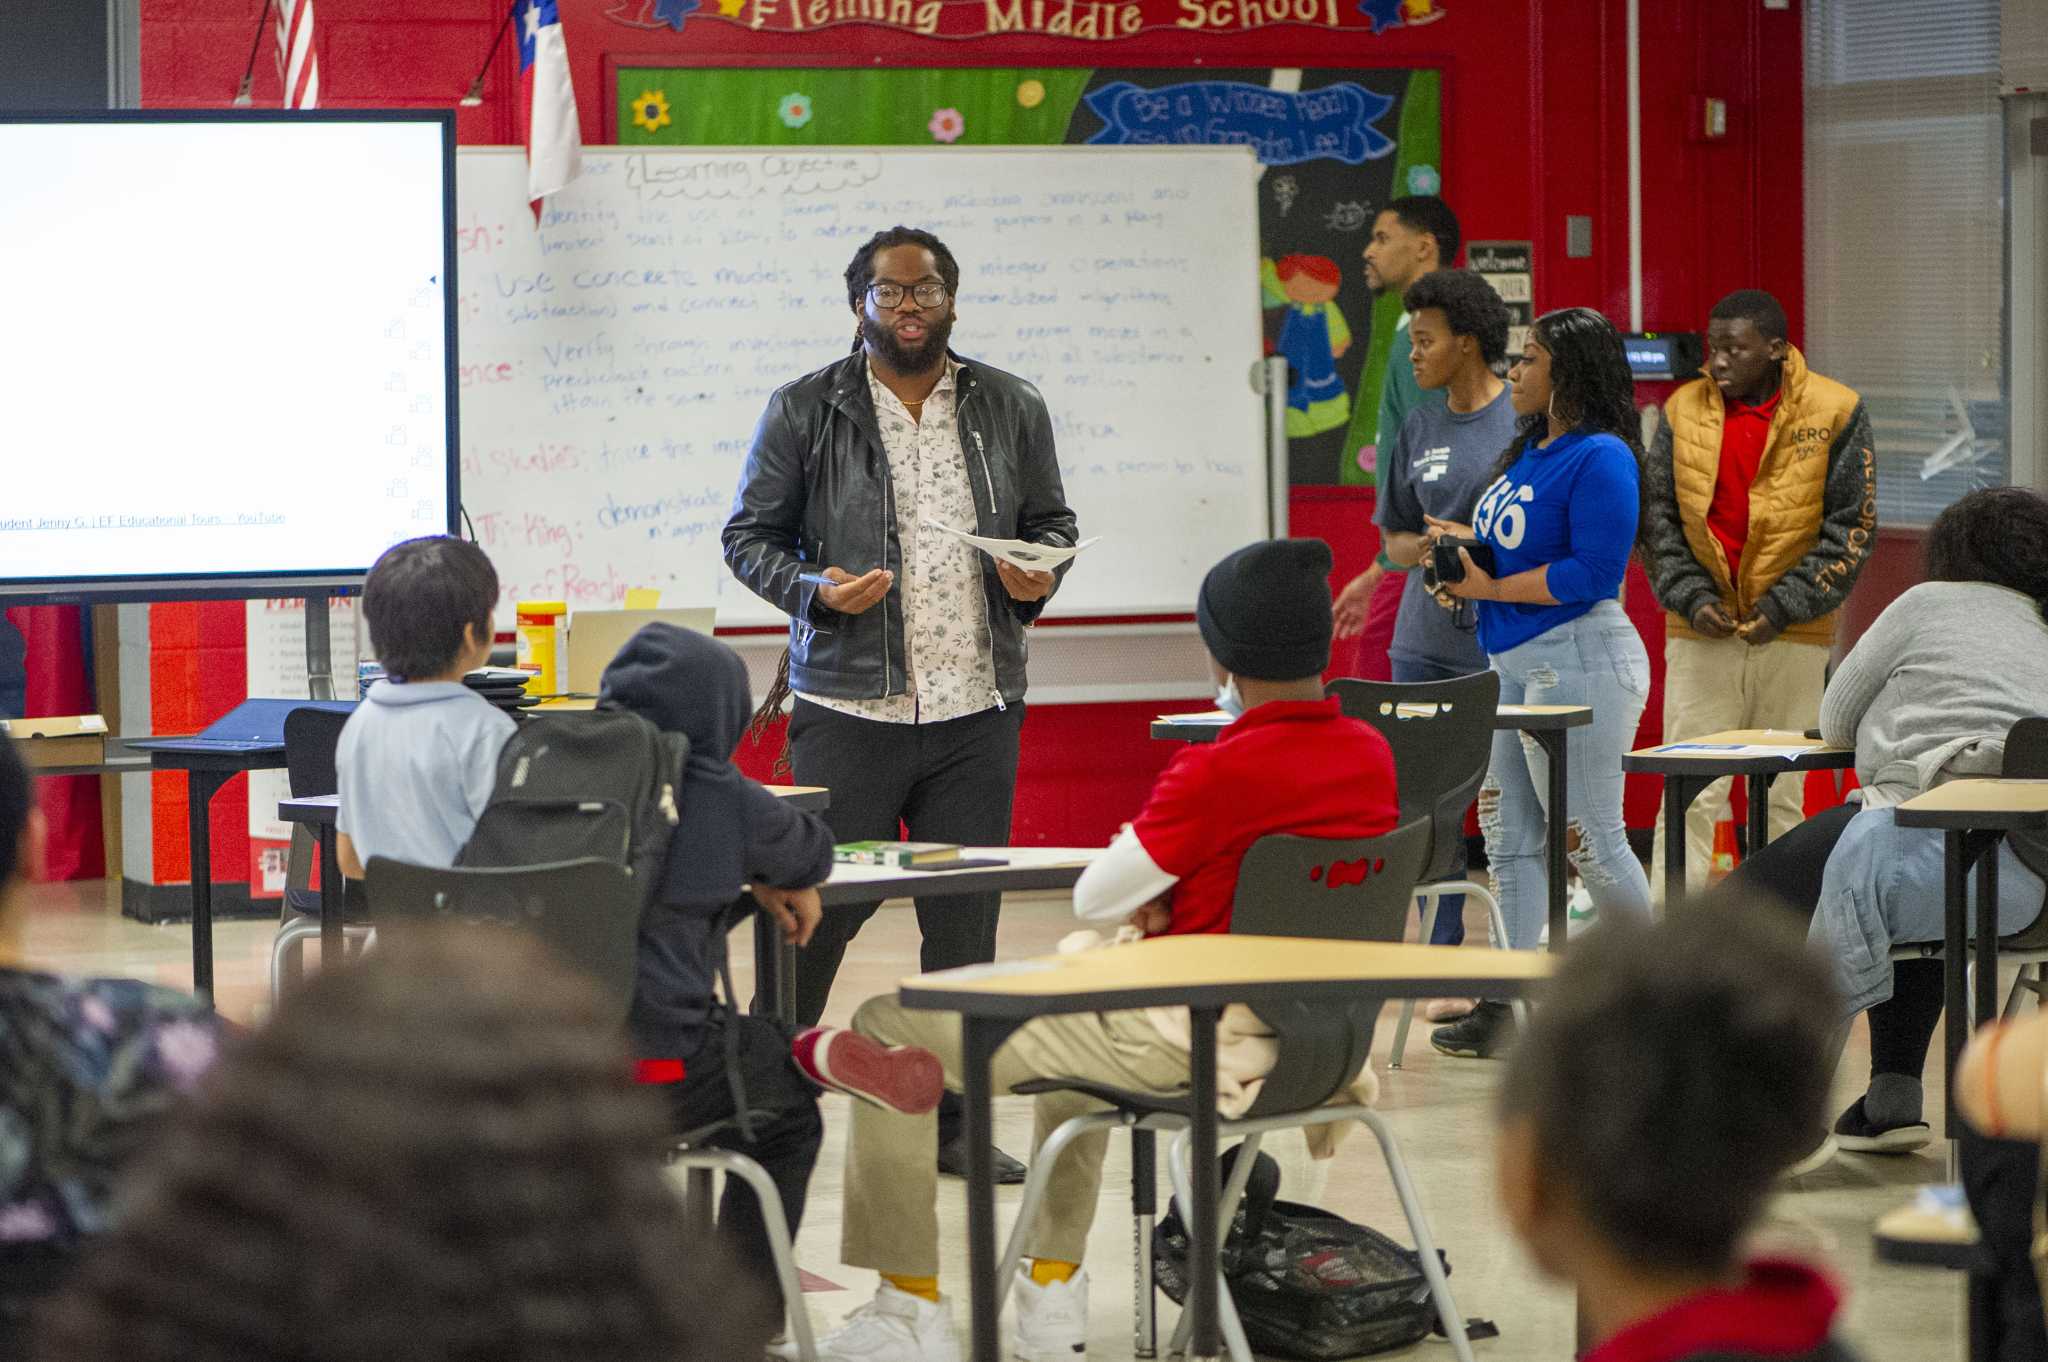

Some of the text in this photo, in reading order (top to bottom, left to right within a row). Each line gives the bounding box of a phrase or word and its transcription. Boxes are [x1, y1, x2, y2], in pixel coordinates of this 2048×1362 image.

[750, 0, 1339, 39] Fleming Middle School
[640, 153, 753, 190] Learning
[572, 258, 699, 290] concrete
[542, 331, 615, 369] Verify
[1791, 428, 1831, 443] AERO
